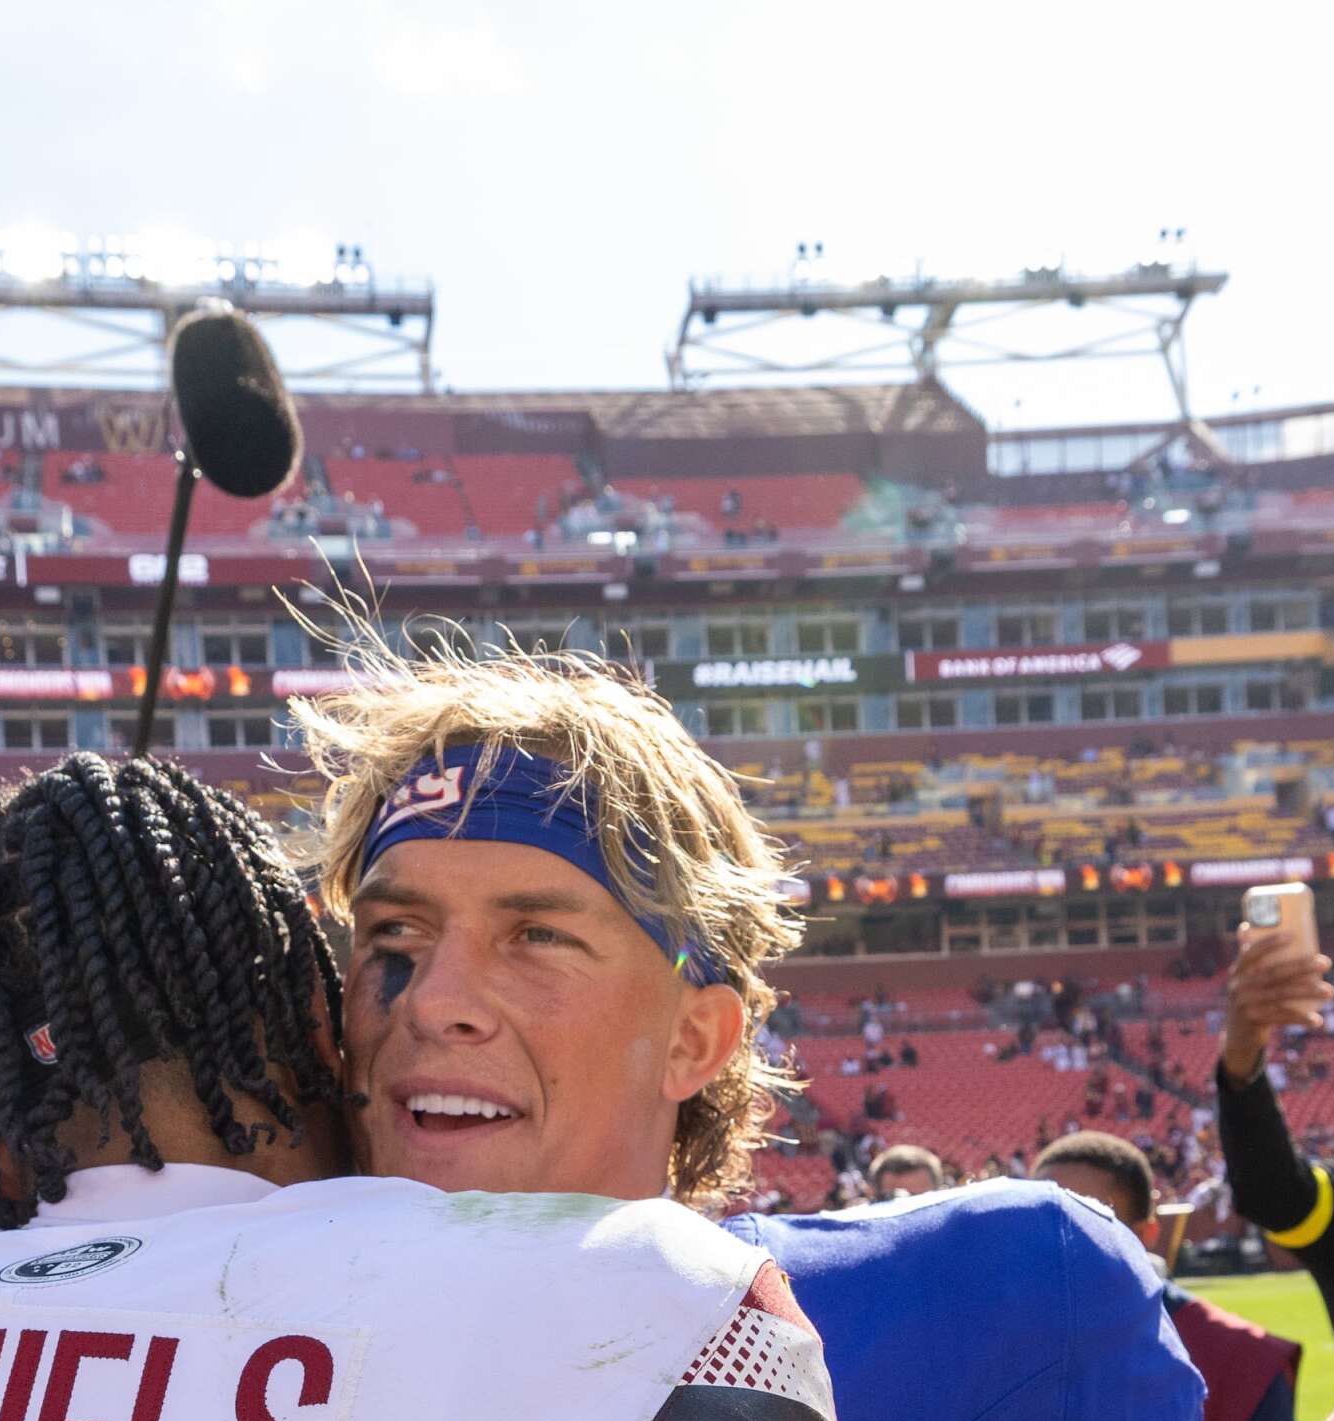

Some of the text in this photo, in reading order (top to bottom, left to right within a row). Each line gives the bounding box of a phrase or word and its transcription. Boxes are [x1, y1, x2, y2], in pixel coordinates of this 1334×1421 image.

[939, 653, 1102, 678] BANK OF AMERICA
